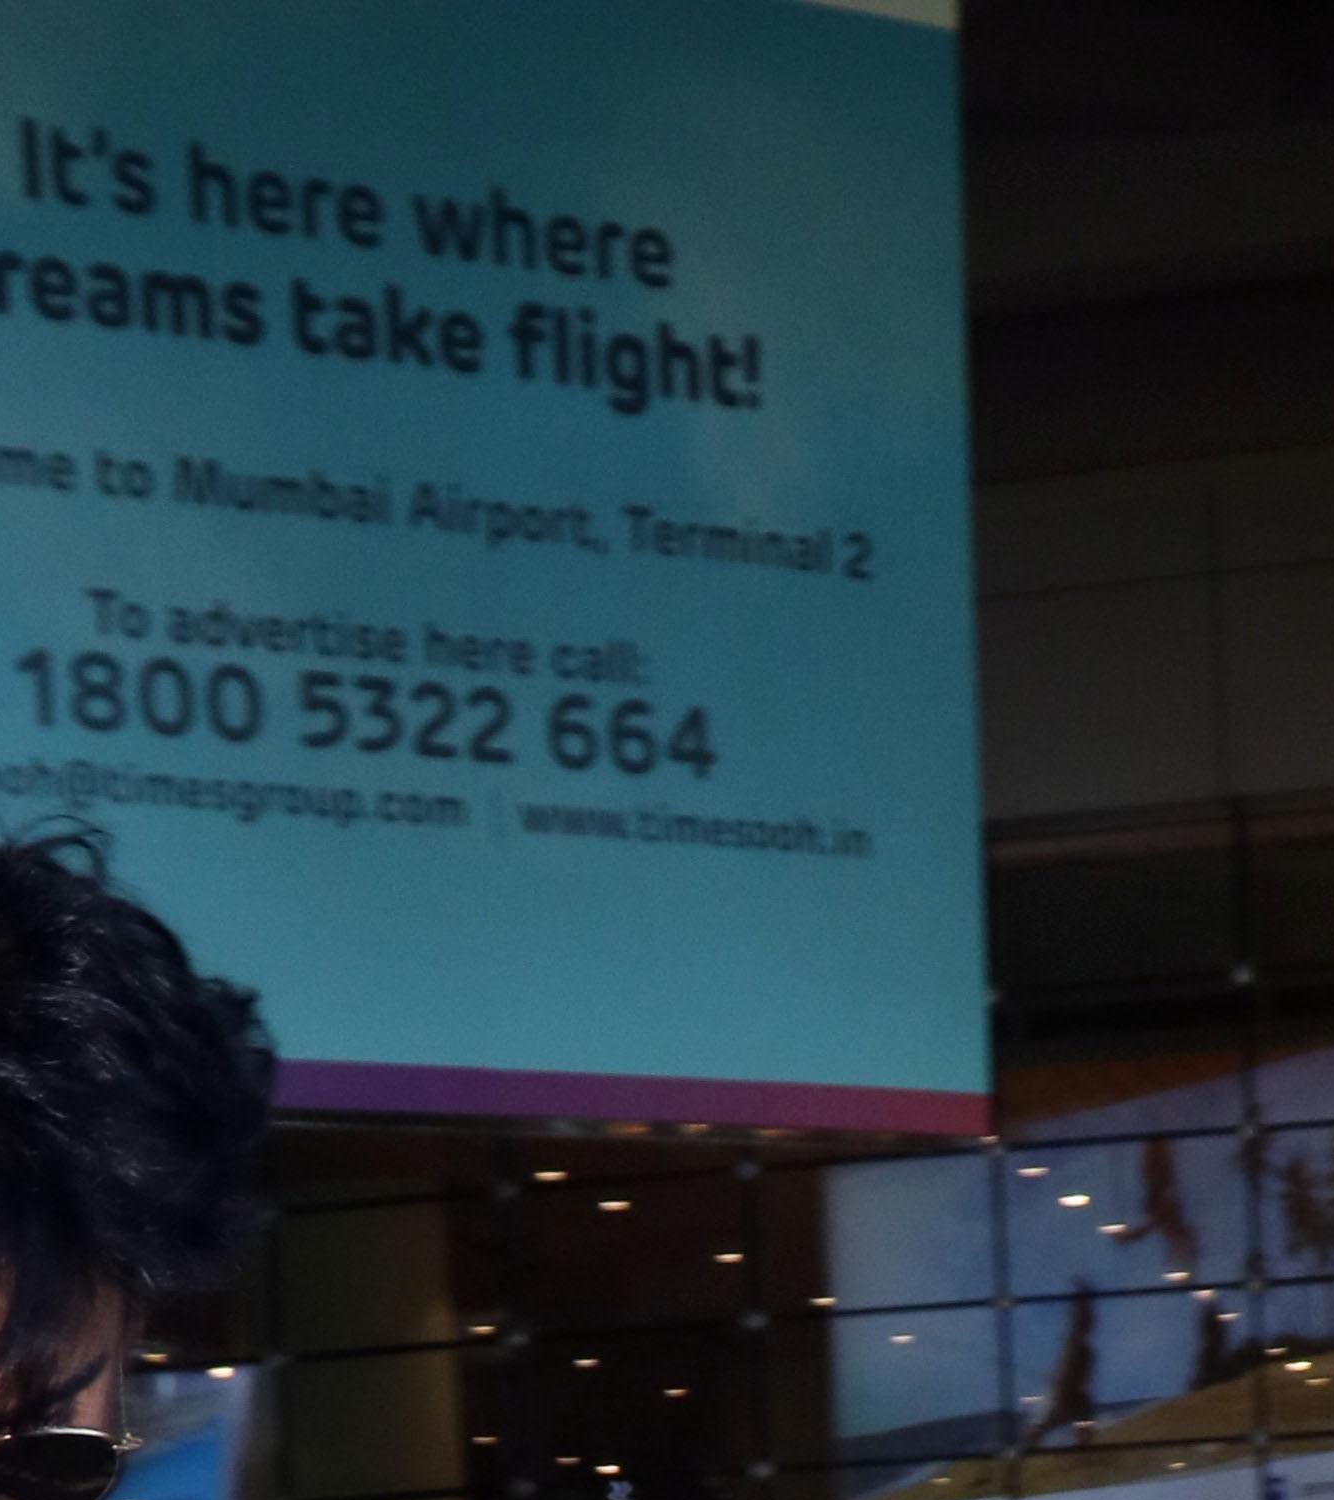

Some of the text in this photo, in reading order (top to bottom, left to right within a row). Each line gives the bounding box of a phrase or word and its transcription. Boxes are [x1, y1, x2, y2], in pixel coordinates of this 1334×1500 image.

[19, 115, 674, 289] It's here where
[289, 275, 485, 376] take
[509, 302, 764, 416] flight!
[93, 448, 159, 500] to
[174, 454, 397, 526] Mumbai
[407, 480, 610, 556] Airport,
[620, 502, 835, 576] Terminal
[841, 531, 874, 581] 2
[86, 588, 150, 640] To
[167, 602, 409, 664] advertise
[423, 620, 535, 678] here
[15, 649, 718, 780] 1800 5322 664
